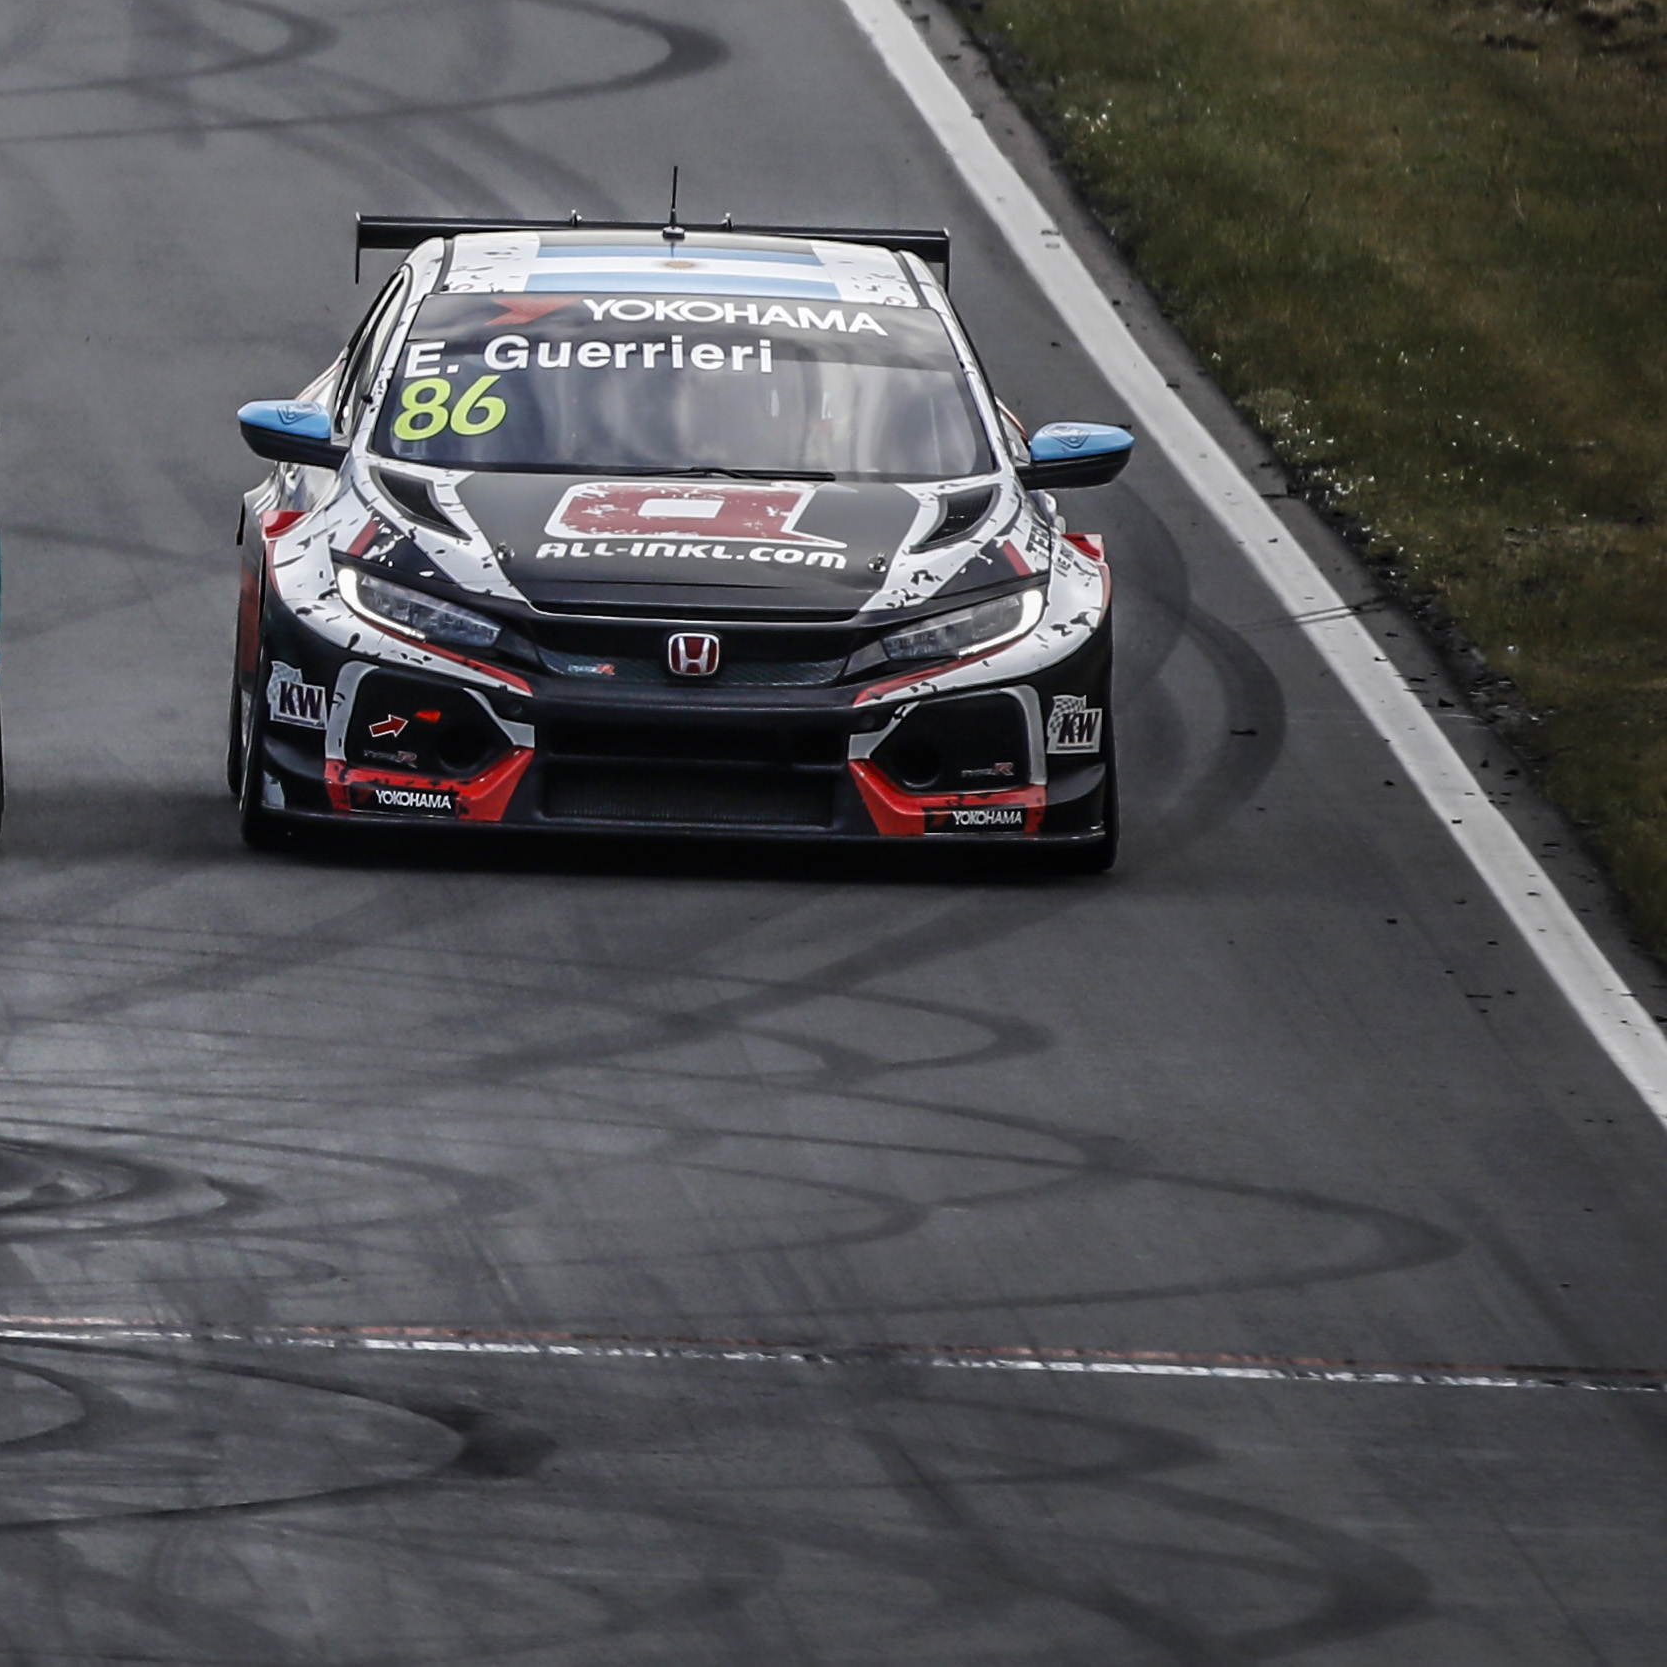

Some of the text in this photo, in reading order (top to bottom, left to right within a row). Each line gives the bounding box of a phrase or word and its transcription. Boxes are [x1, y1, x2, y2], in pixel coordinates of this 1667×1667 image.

[584, 299, 887, 336] YOKOHAMA
[403, 334, 772, 378] E. Guerrieri
[392, 375, 507, 440] 86
[279, 682, 323, 719] KW
[1057, 710, 1102, 745] KW
[375, 789, 451, 809] YOKOHAMA
[952, 811, 1022, 826] YOKOHAMA
